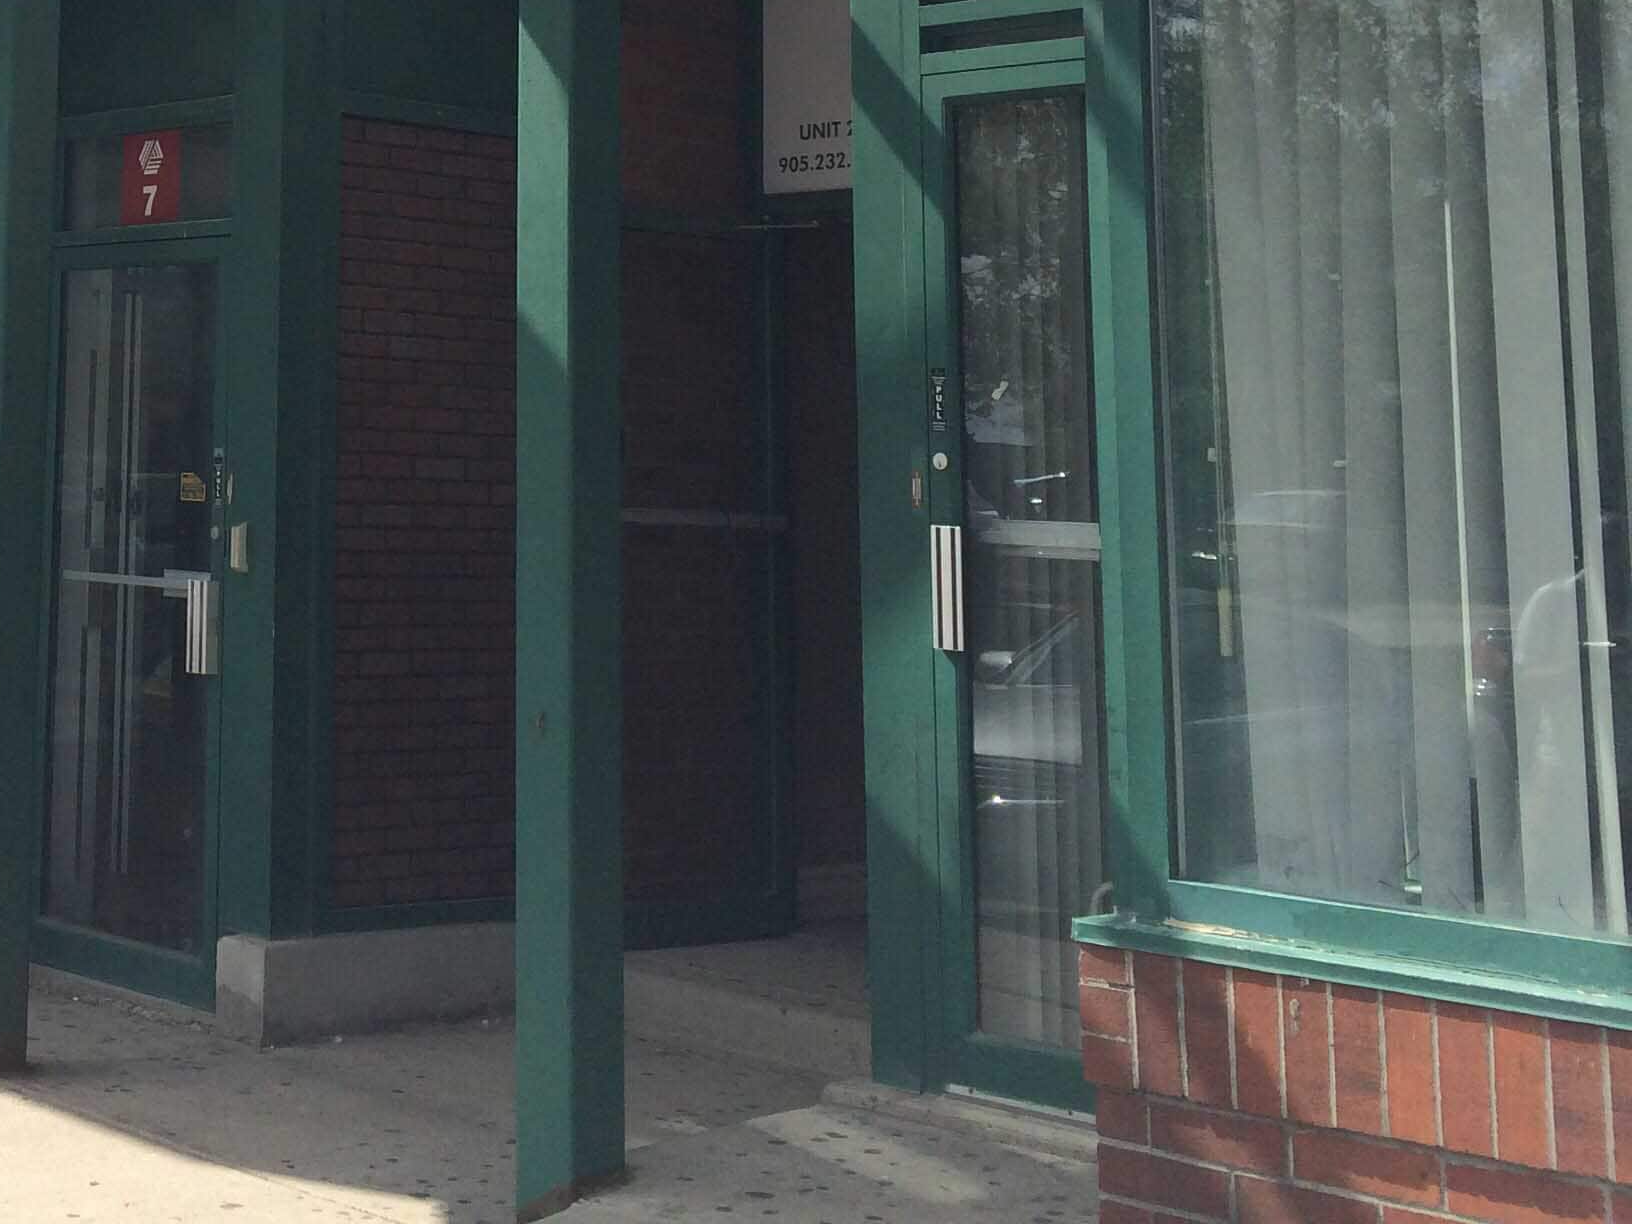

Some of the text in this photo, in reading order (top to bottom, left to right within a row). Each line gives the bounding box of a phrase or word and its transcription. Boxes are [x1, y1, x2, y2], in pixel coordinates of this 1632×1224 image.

[799, 121, 841, 140] UNIT
[142, 185, 158, 216] 7
[935, 385, 943, 420] PULL
